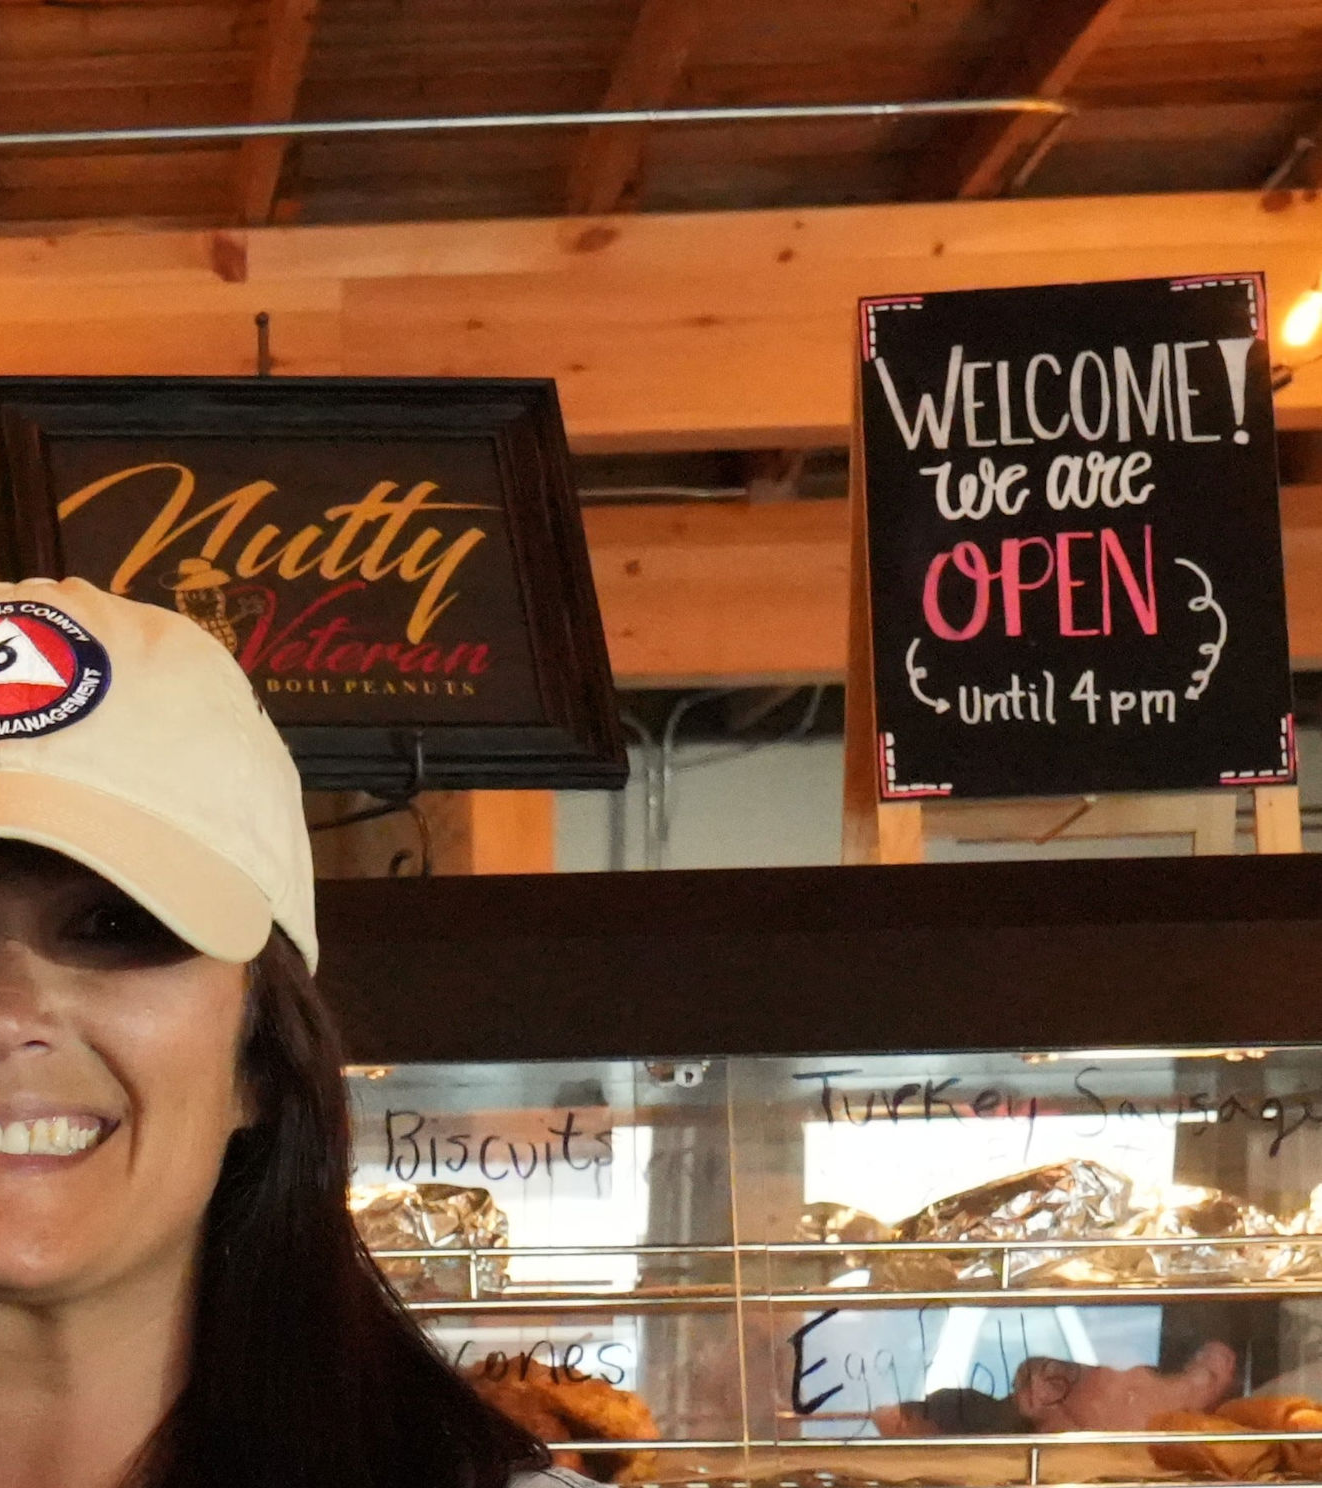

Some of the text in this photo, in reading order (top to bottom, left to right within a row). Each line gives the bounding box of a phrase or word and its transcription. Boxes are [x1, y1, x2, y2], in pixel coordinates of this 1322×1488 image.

[874, 337, 1256, 451] WELCOME!
[919, 449, 1156, 521] we are
[57, 461, 506, 645] Nutty
[921, 523, 1157, 642] OPEN
[19, 602, 91, 643] COUNTY
[224, 579, 492, 675] Veteran
[344, 678, 478, 697] PEANUTS
[384, 1108, 616, 1182] Biscuits
[454, 1339, 632, 1385] cones
[787, 1307, 904, 1440] Egg
